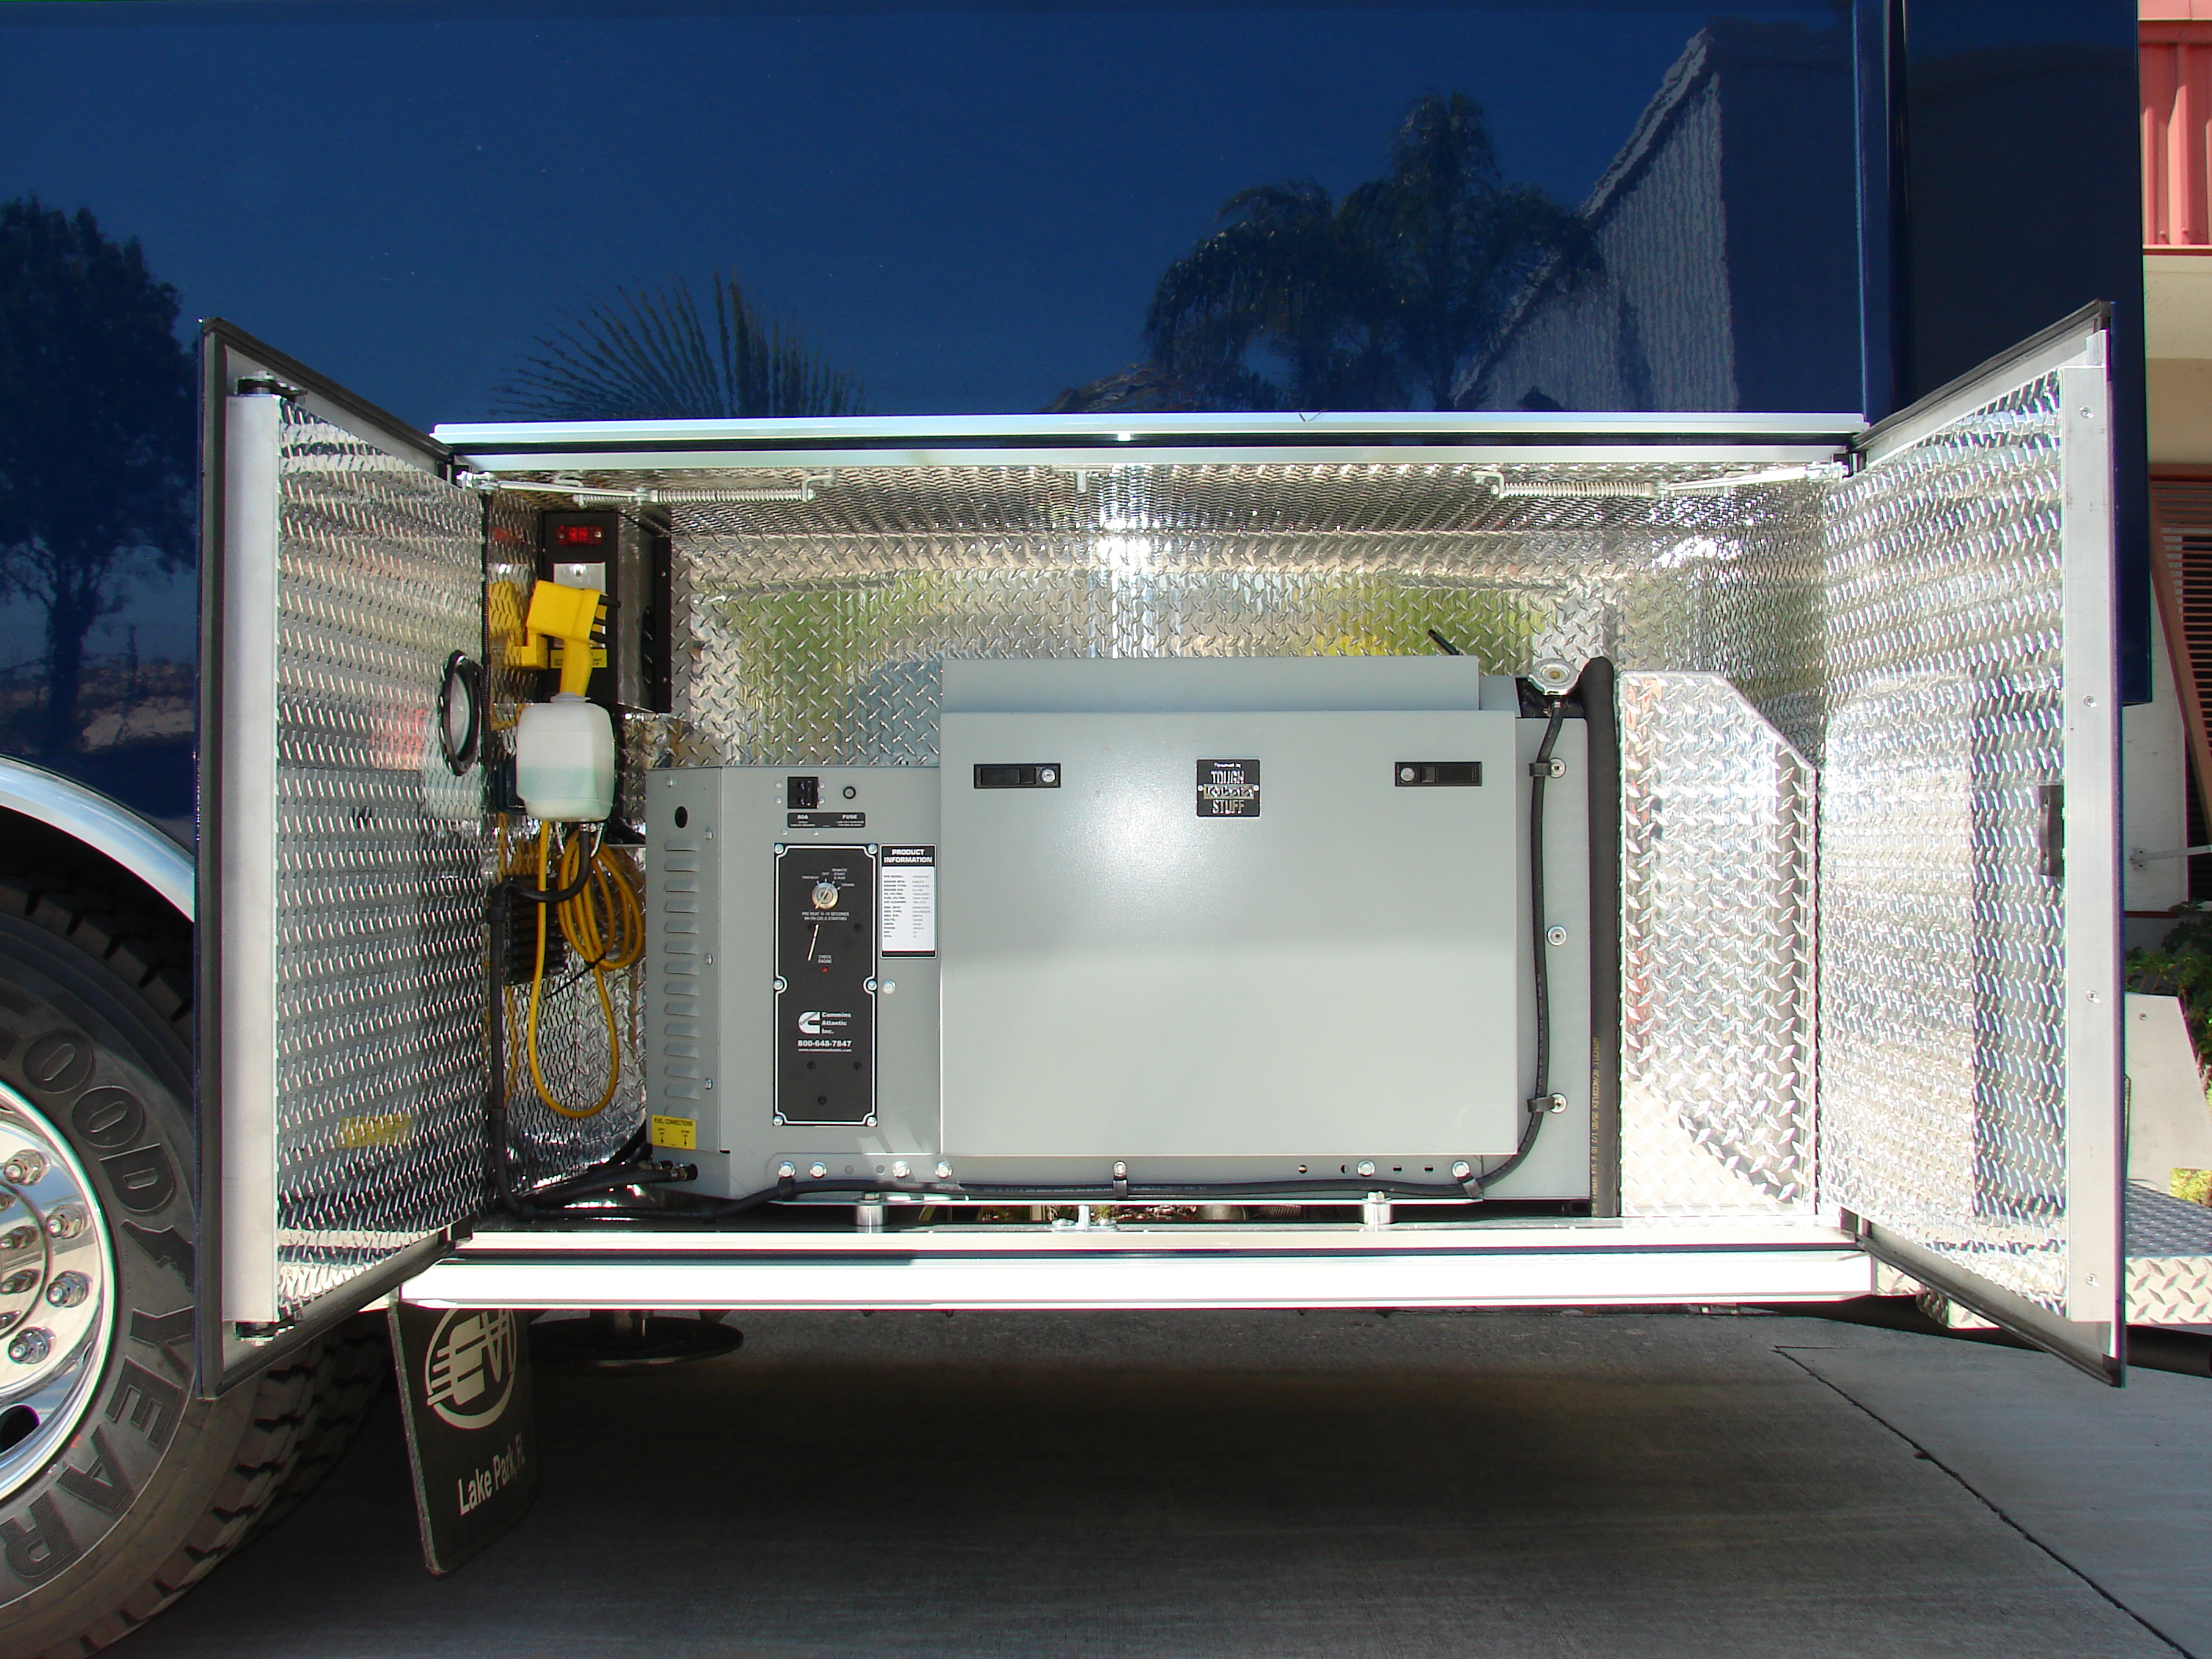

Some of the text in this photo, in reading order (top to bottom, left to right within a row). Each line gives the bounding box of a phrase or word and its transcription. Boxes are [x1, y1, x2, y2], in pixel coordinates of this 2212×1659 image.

[1210, 770, 1245, 784] TOUGH
[1207, 785, 1253, 797] Kubota
[1211, 799, 1245, 814] STUFF
[458, 1467, 493, 1516] Lake
